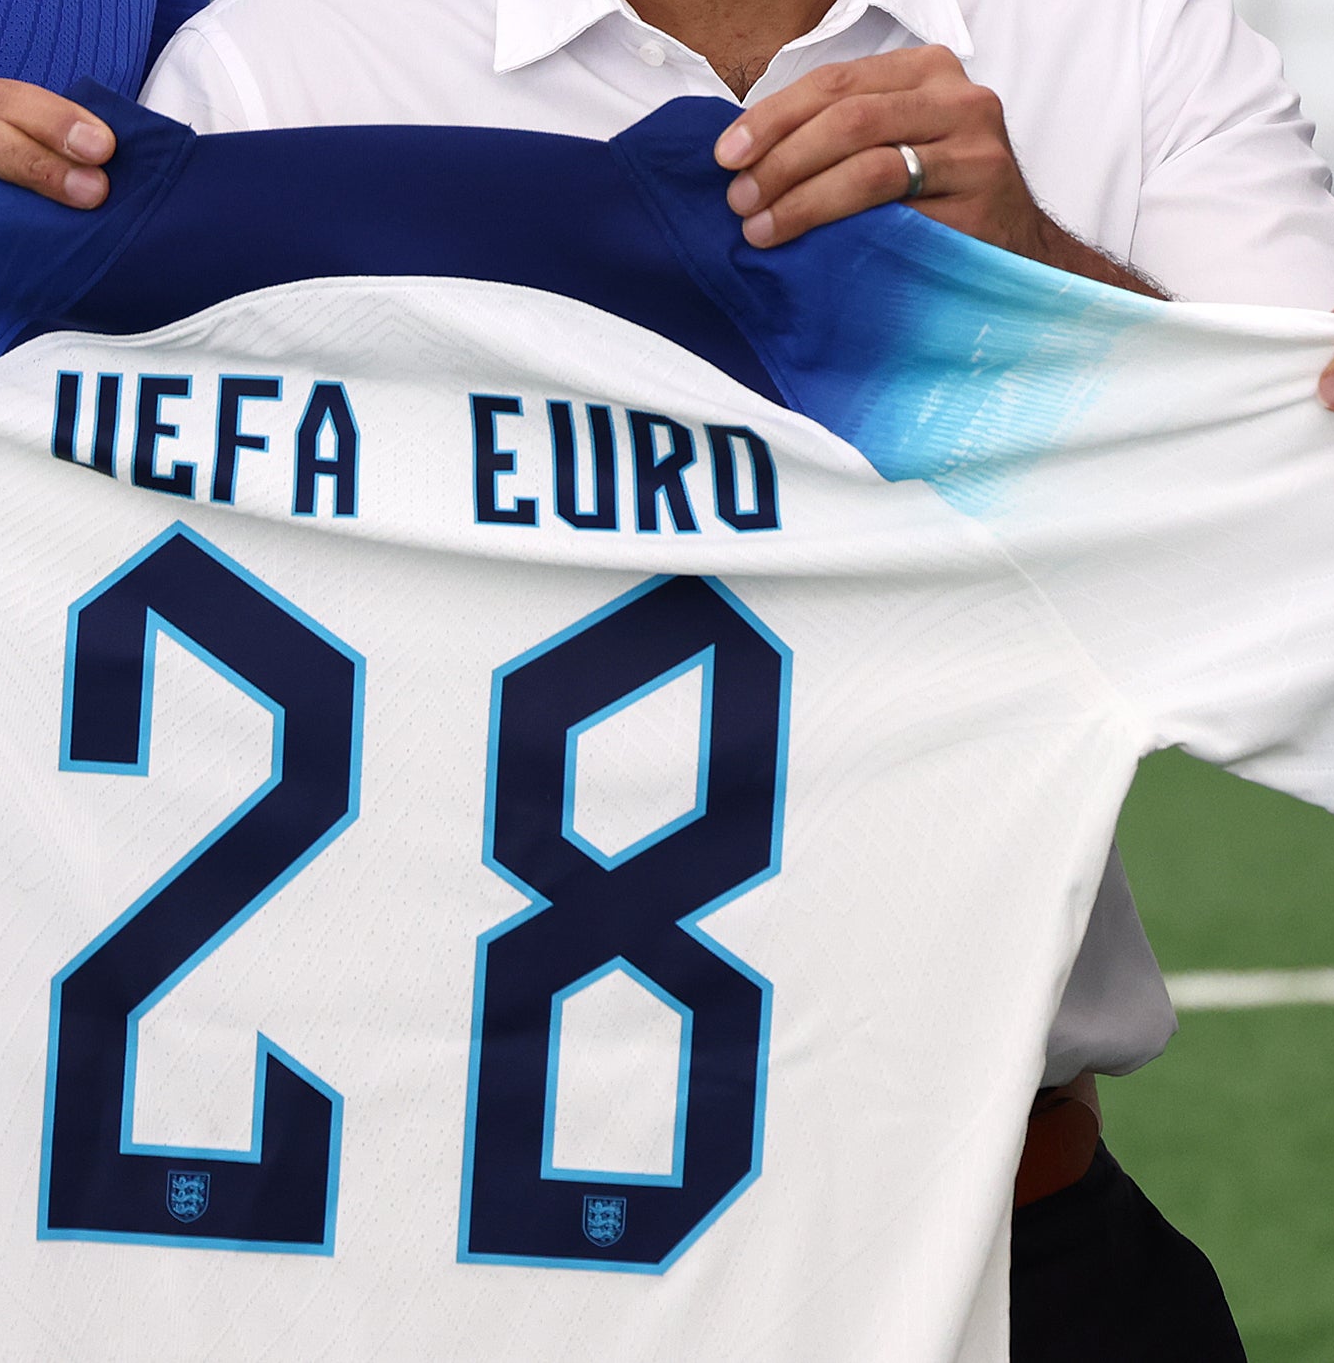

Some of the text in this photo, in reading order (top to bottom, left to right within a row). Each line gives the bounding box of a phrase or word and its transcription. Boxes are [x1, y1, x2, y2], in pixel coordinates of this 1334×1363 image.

[51, 369, 783, 535] UEFA EURO
[36, 519, 794, 1276] 28
